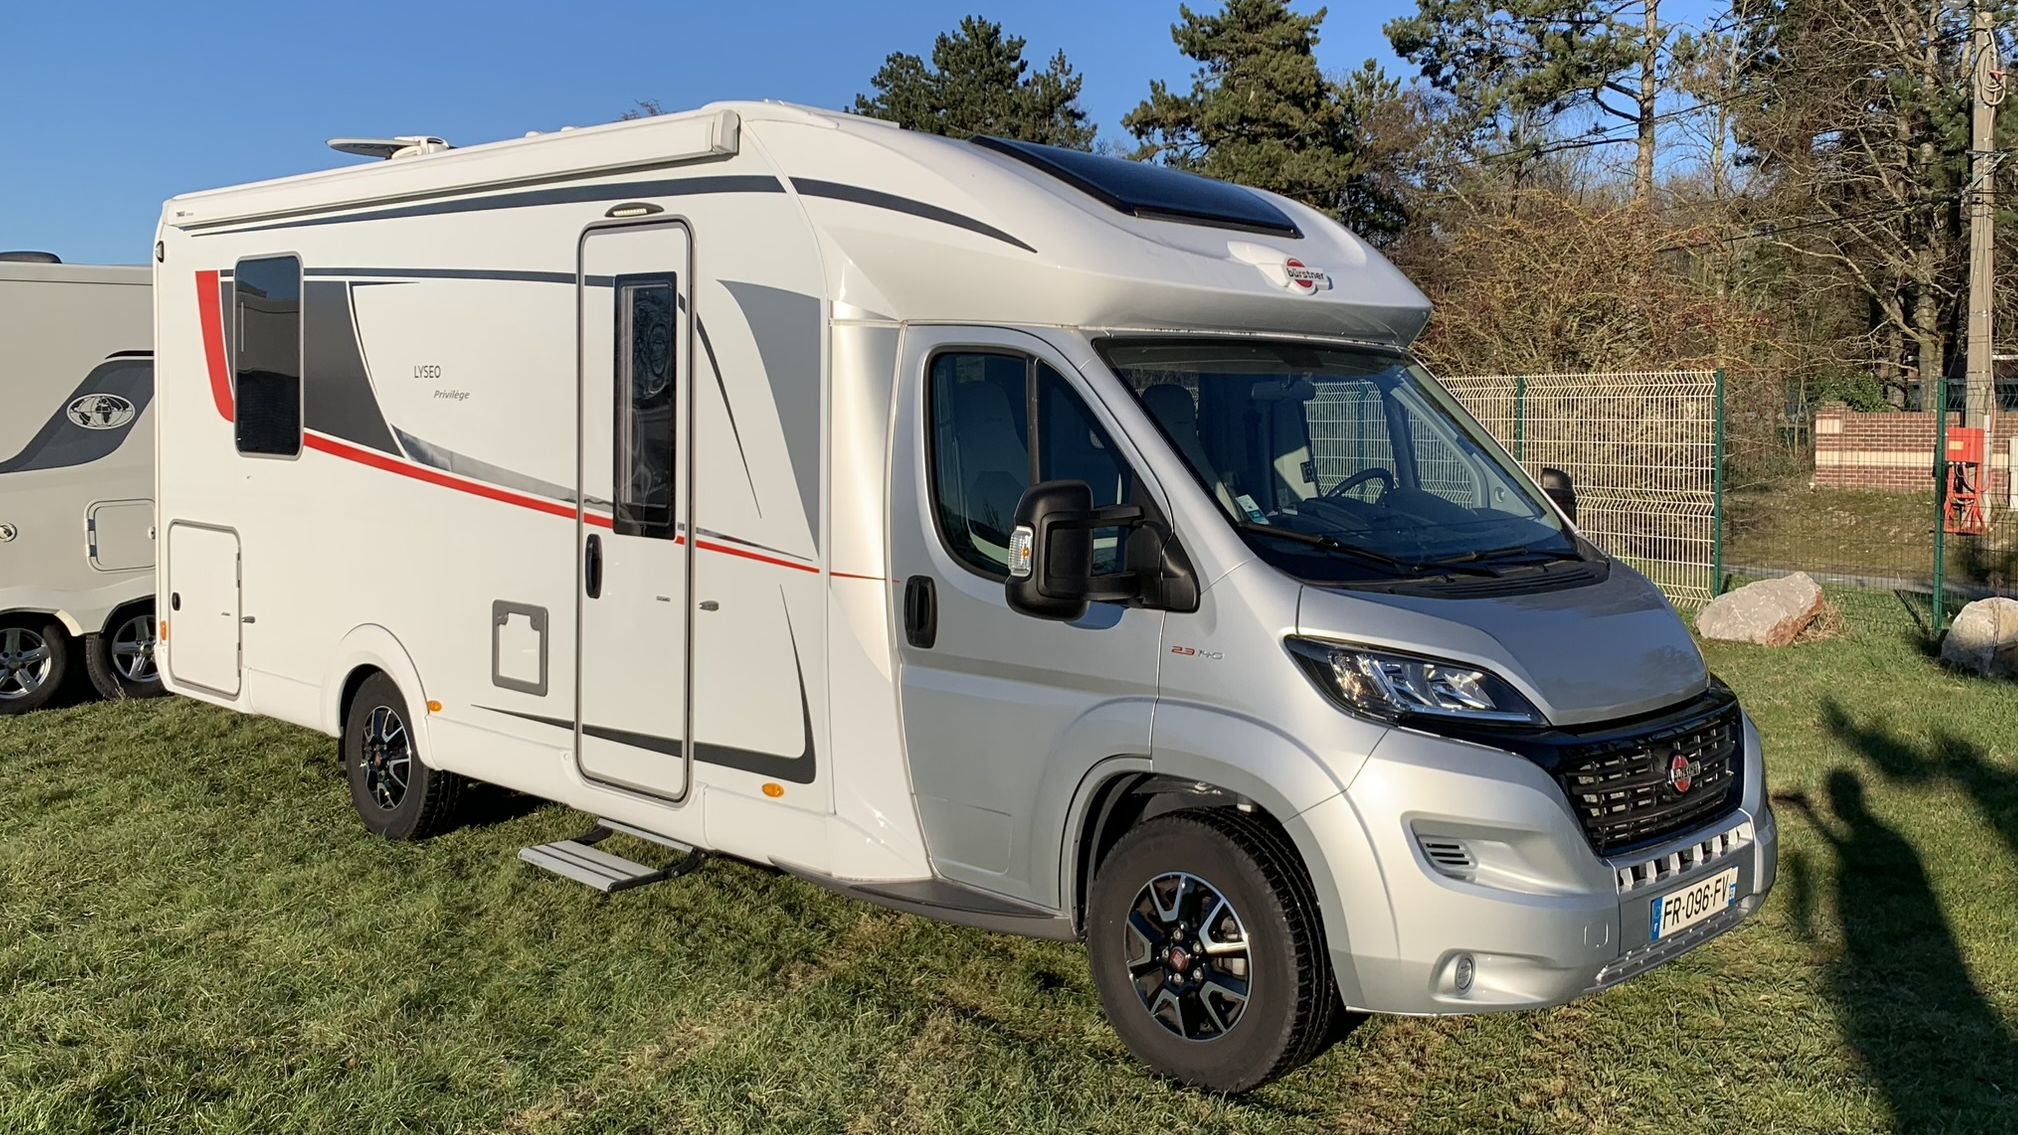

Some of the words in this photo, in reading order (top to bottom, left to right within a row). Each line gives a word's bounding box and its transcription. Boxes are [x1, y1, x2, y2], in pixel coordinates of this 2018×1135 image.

[1286, 267, 1325, 280] bürstner
[413, 364, 442, 379] LYSEO
[433, 389, 471, 401] Privilège
[1662, 873, 1730, 930] FR-096-FV
